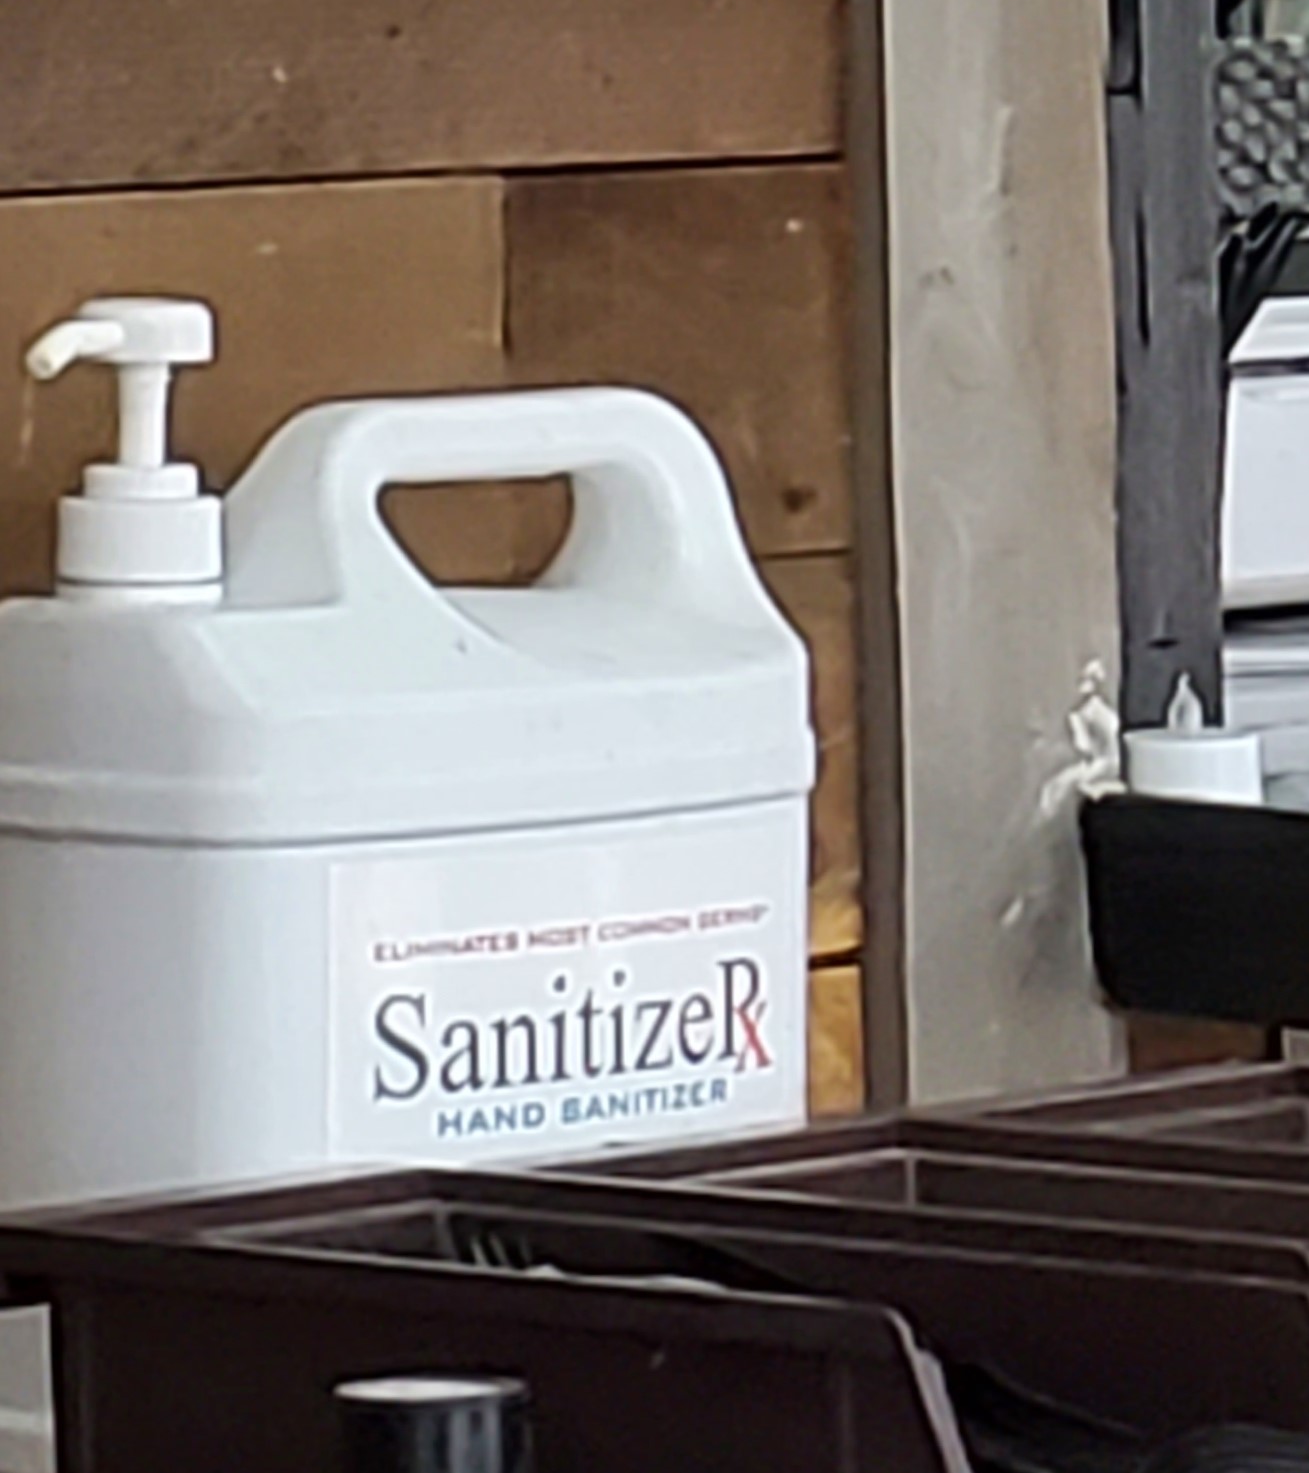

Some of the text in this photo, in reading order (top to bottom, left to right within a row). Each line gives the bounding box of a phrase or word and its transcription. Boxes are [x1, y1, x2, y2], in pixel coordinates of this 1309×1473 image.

[373, 929, 520, 962] ELIMINATES
[526, 924, 592, 949] MOST
[436, 1078, 729, 1139] HAND SANITIZER
